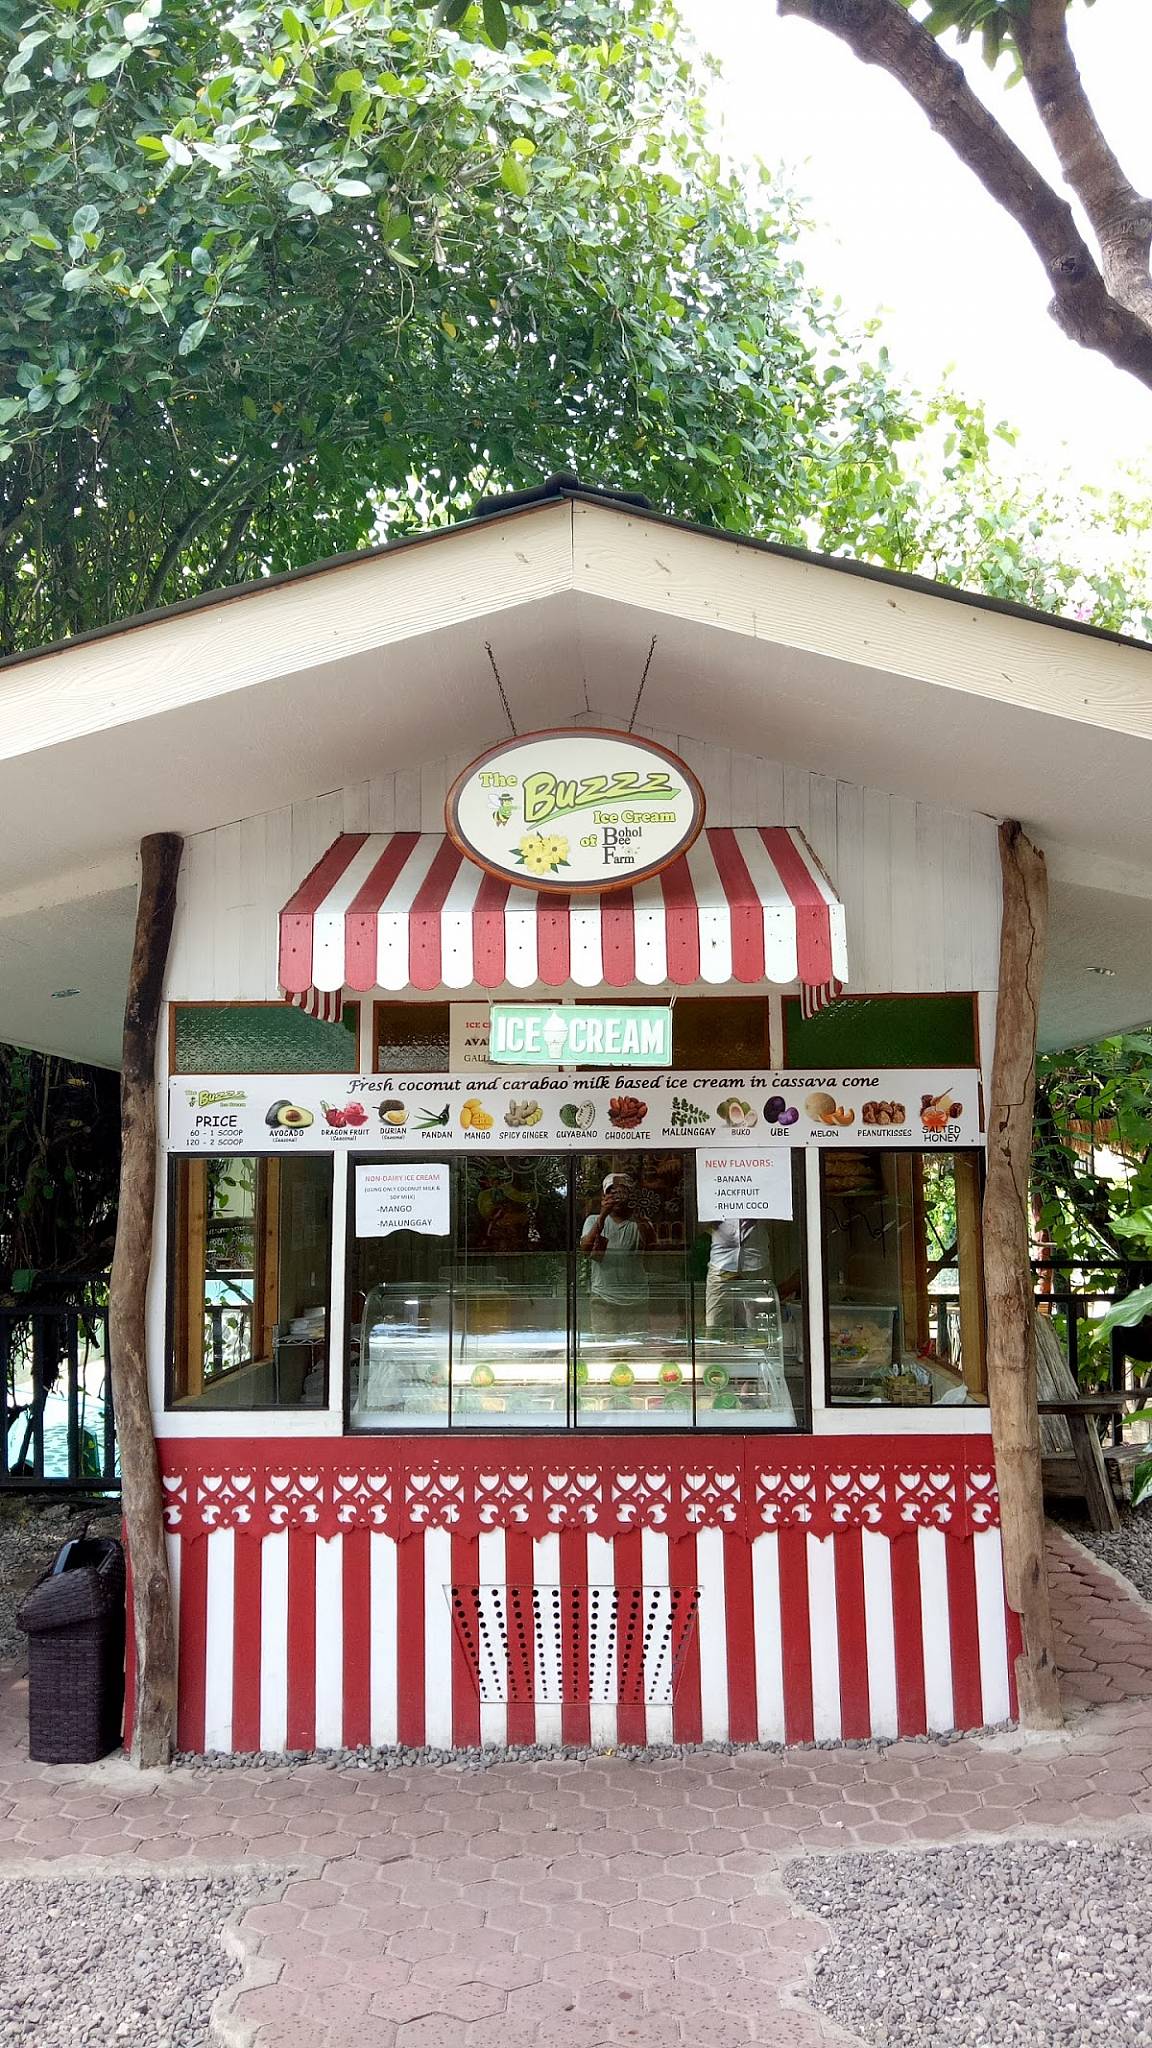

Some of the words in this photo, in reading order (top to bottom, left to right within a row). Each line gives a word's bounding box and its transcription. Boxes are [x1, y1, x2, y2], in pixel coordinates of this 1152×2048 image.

[479, 772, 518, 788] The
[522, 771, 672, 822] Buzzz
[593, 811, 618, 824] Ice
[621, 810, 676, 824] Cream
[580, 834, 597, 847] of
[602, 826, 642, 845] Bohol
[602, 846, 635, 864] Farm
[497, 1016, 541, 1053] ICE
[569, 1018, 664, 1055] CREAM
[464, 1038, 488, 1046] AVA
[463, 1054, 489, 1062] GALL
[347, 1077, 394, 1094] Fresh
[398, 1079, 461, 1091] coconut
[466, 1077, 502, 1090] and
[503, 1077, 568, 1090] carabao
[573, 1076, 610, 1090] milk
[615, 1075, 664, 1089] based
[666, 1076, 687, 1088] ice
[693, 1077, 745, 1088] cream
[750, 1075, 767, 1088] in
[771, 1076, 837, 1088] cassava
[842, 1077, 880, 1087] cone
[196, 1115, 238, 1127] PRICE
[190, 1129, 200, 1137] 60
[217, 1129, 244, 1137] SCOOP
[269, 1129, 305, 1137] AVOCADO
[349, 1128, 370, 1136] FRUIT
[379, 1127, 407, 1135] DURIAN
[661, 1127, 716, 1136] MALUNGGAY
[731, 1128, 751, 1136] BUKO
[770, 1127, 790, 1137] UBE
[810, 1130, 839, 1138] MELON
[921, 1125, 961, 1134] SALTED
[421, 1131, 453, 1139] PANDAN
[464, 1131, 491, 1140] MANGO
[499, 1131, 522, 1140] SPICY
[522, 1131, 549, 1139] GINGER
[556, 1130, 598, 1139] GUYABANO
[604, 1131, 651, 1140] CHOCOLATE
[924, 1133, 960, 1142] HONEY
[705, 1160, 728, 1168] NEW
[729, 1159, 774, 1168] FLAVORS:
[714, 1175, 753, 1183] -BANANA
[714, 1188, 760, 1196] -JACKFRUIT
[377, 1205, 413, 1213] -MANGO
[715, 1202, 744, 1210] -RHUM
[745, 1201, 769, 1210] COCO
[377, 1219, 433, 1227] -MALUNGGAY
